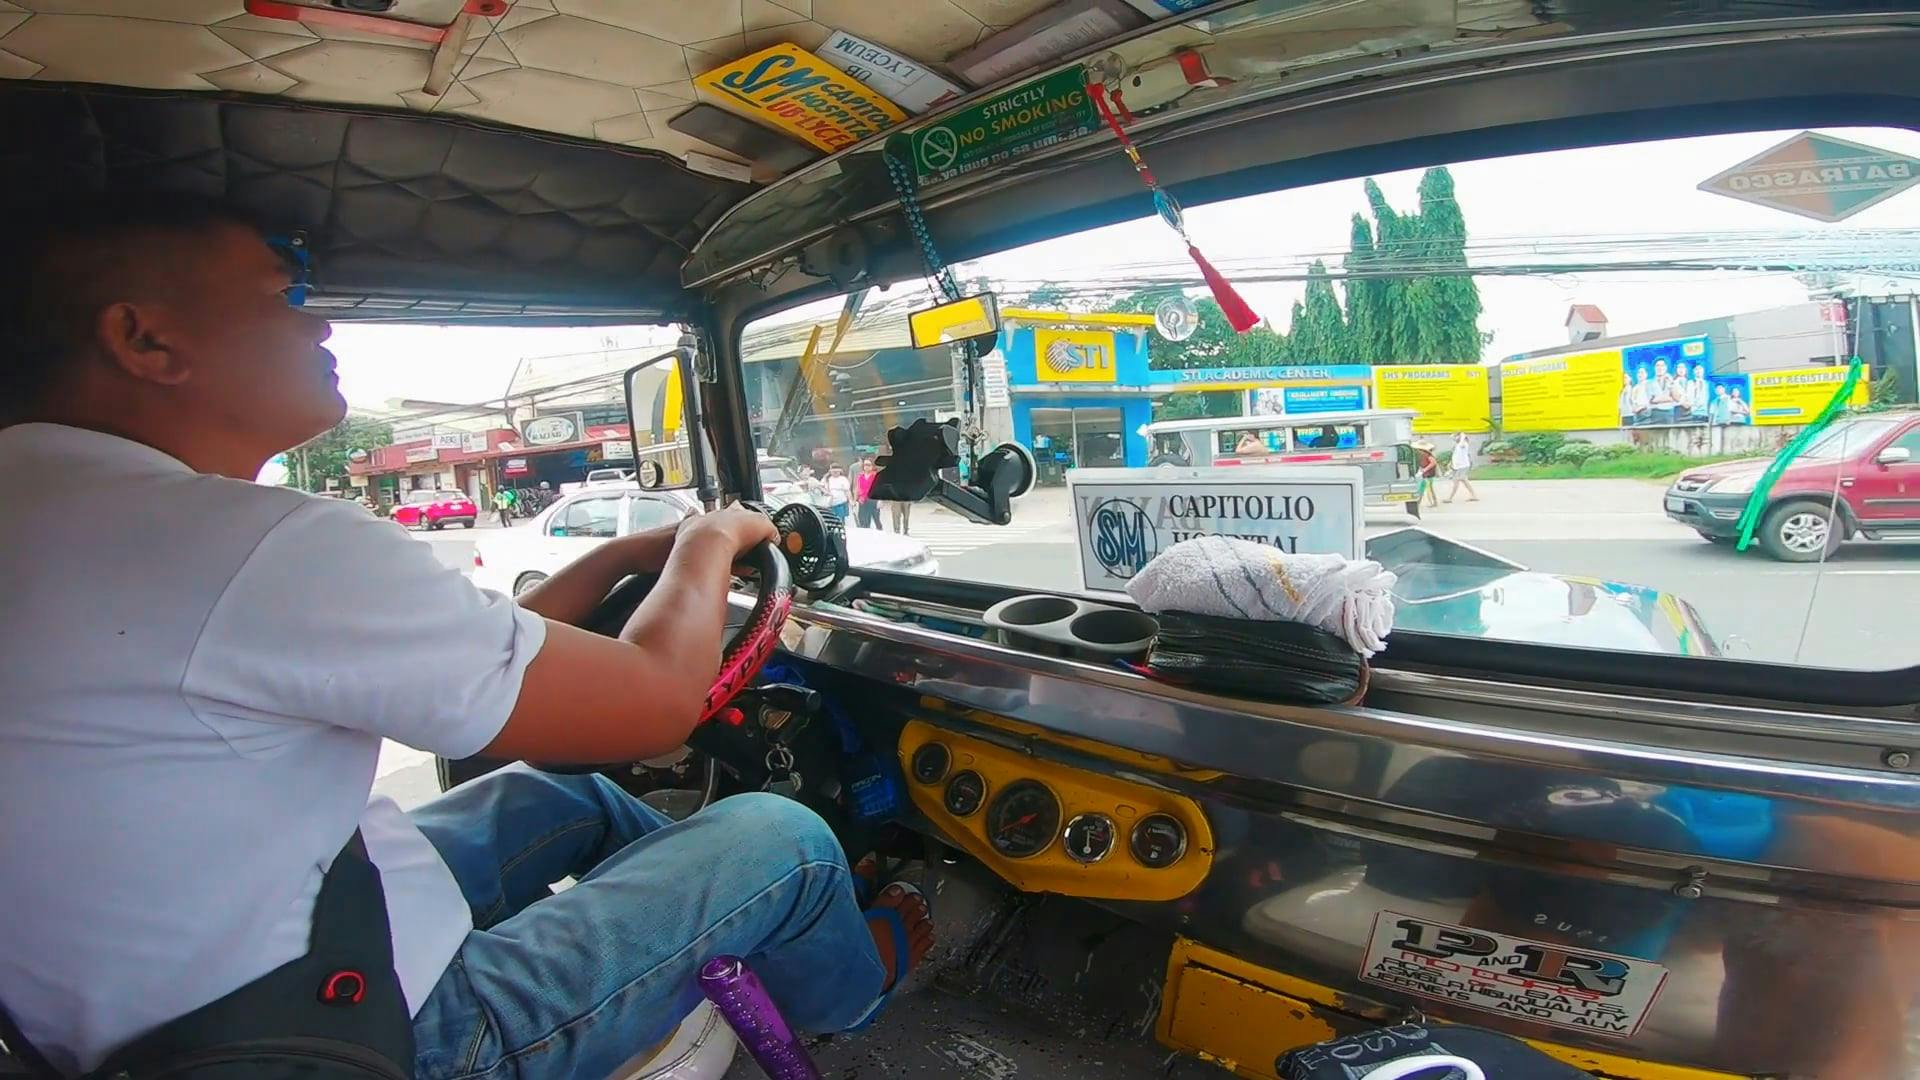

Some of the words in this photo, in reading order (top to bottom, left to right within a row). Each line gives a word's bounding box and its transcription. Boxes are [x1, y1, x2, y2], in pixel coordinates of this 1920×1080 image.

[835, 37, 916, 79] LYCEUM
[721, 54, 830, 103] SM
[845, 64, 873, 82] UB
[983, 85, 1046, 119] STRICTLY
[959, 127, 985, 147] NO
[991, 90, 1083, 135] SMOKING
[1065, 343, 1110, 369] STI
[1204, 368, 1275, 382] ACADEMIC
[1277, 367, 1330, 380] CENTER
[1169, 494, 1315, 521] CAPITOLIO
[1477, 954, 1523, 967] AND
[1367, 973, 1471, 1001] JEEPNEYS
[1496, 1001, 1553, 1018] AND
[1572, 1016, 1628, 1031] AUV
[1515, 996, 1629, 1021] QUALITY
